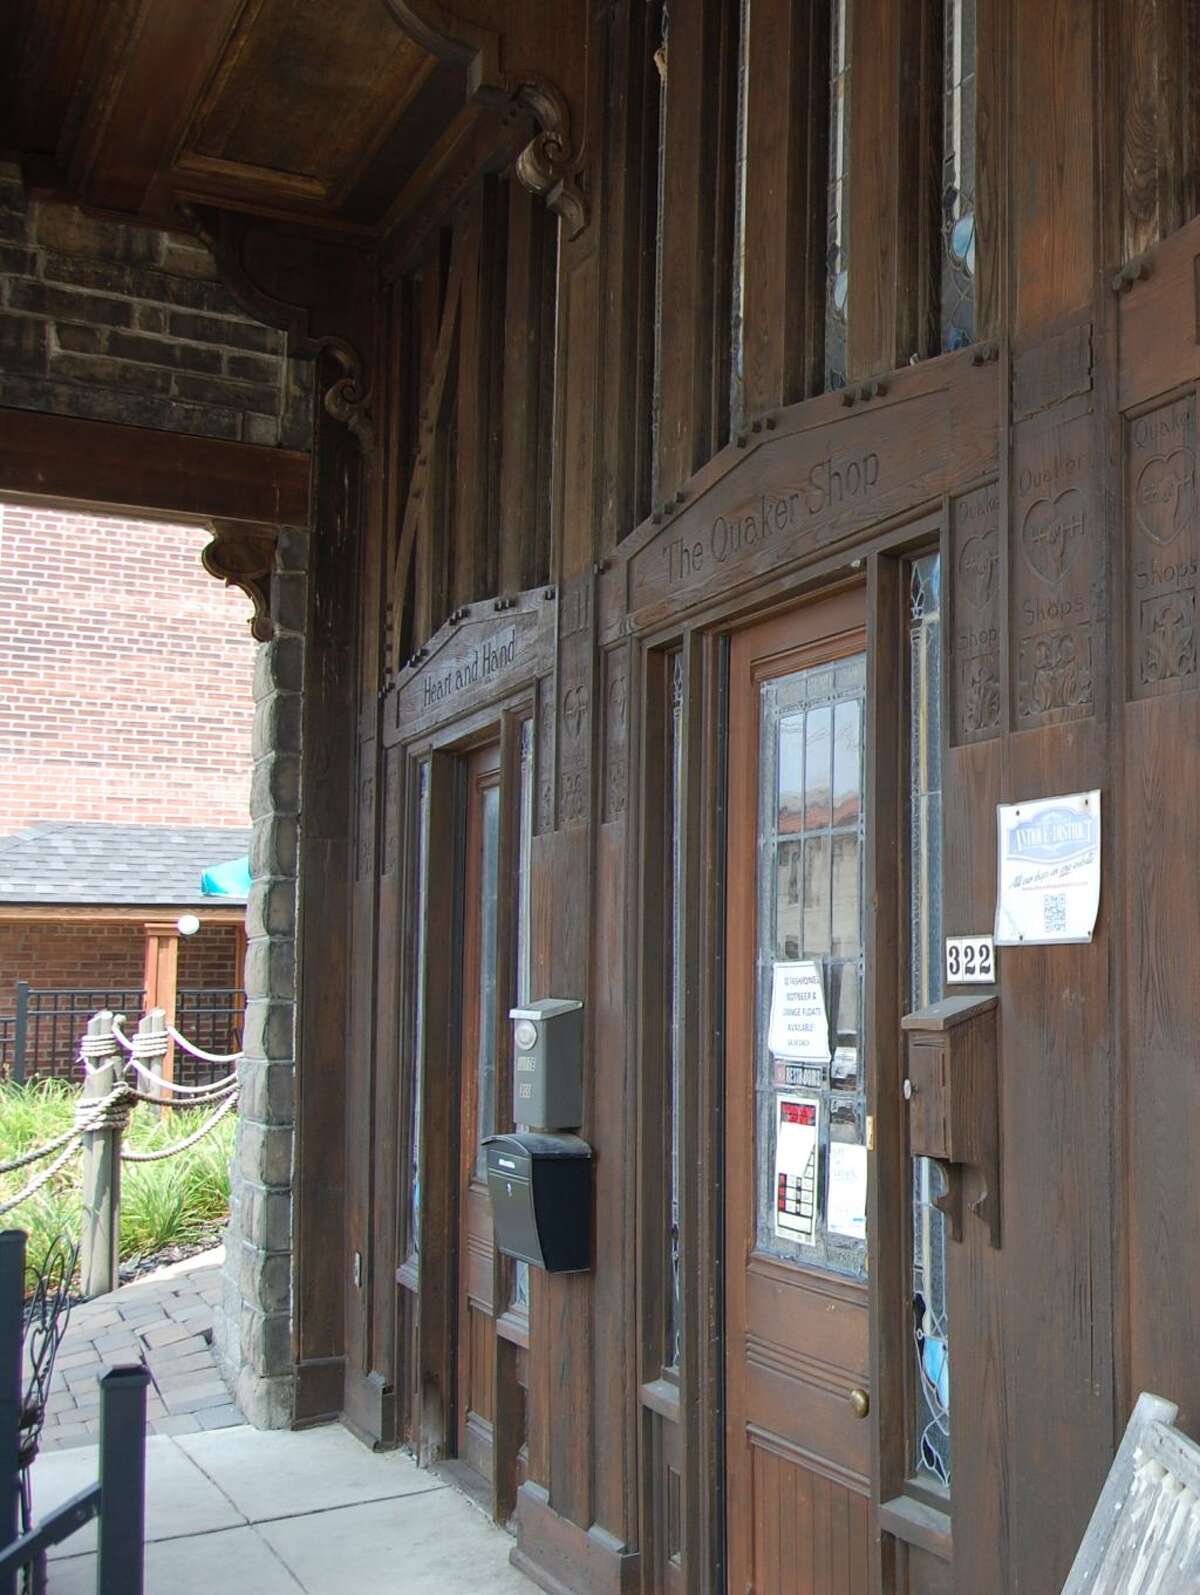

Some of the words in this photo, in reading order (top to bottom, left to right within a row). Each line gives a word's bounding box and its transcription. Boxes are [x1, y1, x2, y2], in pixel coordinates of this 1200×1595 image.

[662, 535, 704, 584] The
[710, 494, 800, 563] Quaker
[805, 452, 880, 515] Shop
[455, 650, 478, 690] and
[482, 628, 516, 678] Hand
[949, 944, 992, 975] 322
